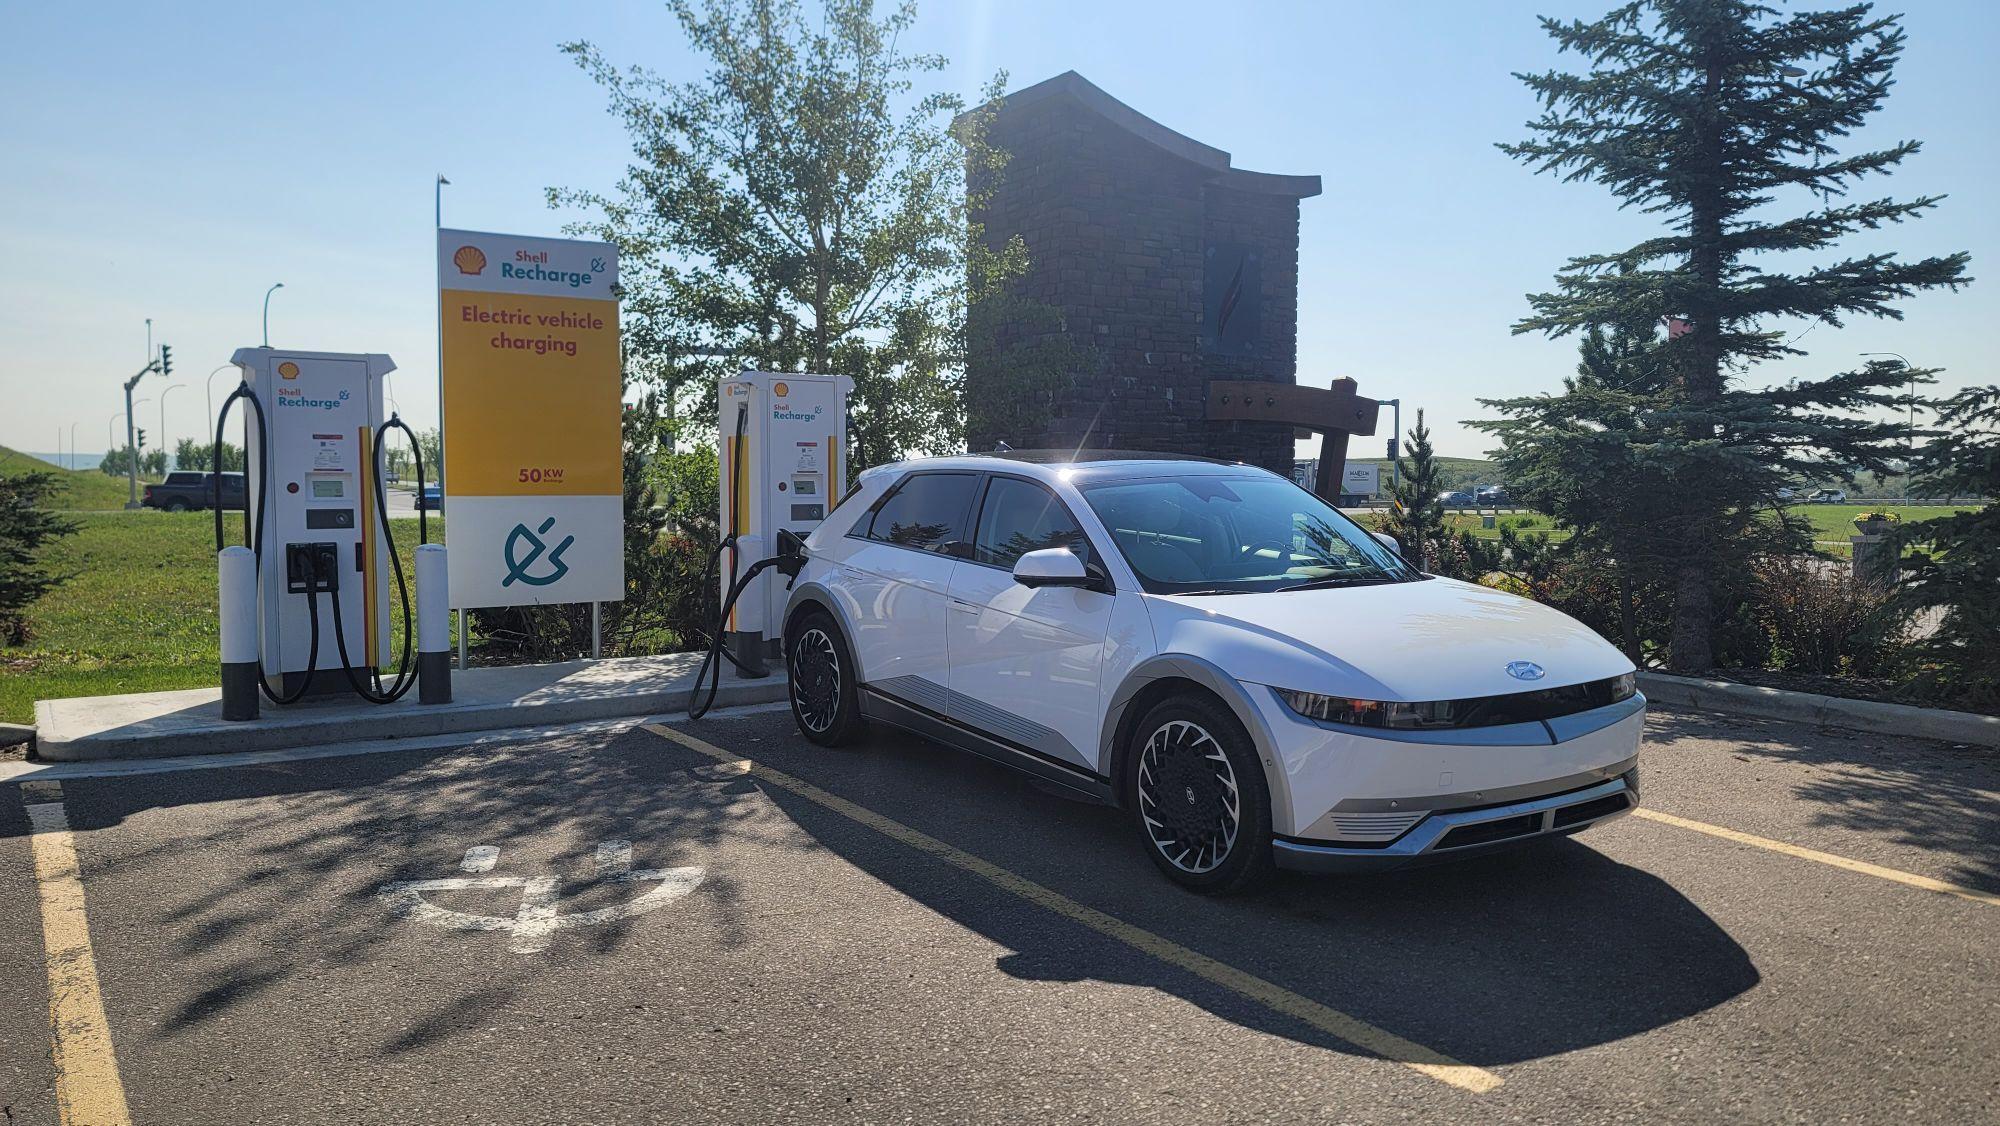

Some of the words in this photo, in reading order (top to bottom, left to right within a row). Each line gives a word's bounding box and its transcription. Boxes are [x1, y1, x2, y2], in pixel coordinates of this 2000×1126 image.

[515, 250, 548, 264] Shell
[501, 262, 592, 288] Recharge
[462, 305, 532, 325] Electric
[537, 310, 604, 330] vehicle
[490, 331, 577, 356] charging
[278, 388, 301, 396] Shell
[278, 396, 341, 410] Recharge
[773, 411, 816, 422] Recharge
[519, 468, 542, 483] 50
[543, 468, 564, 478] KW
